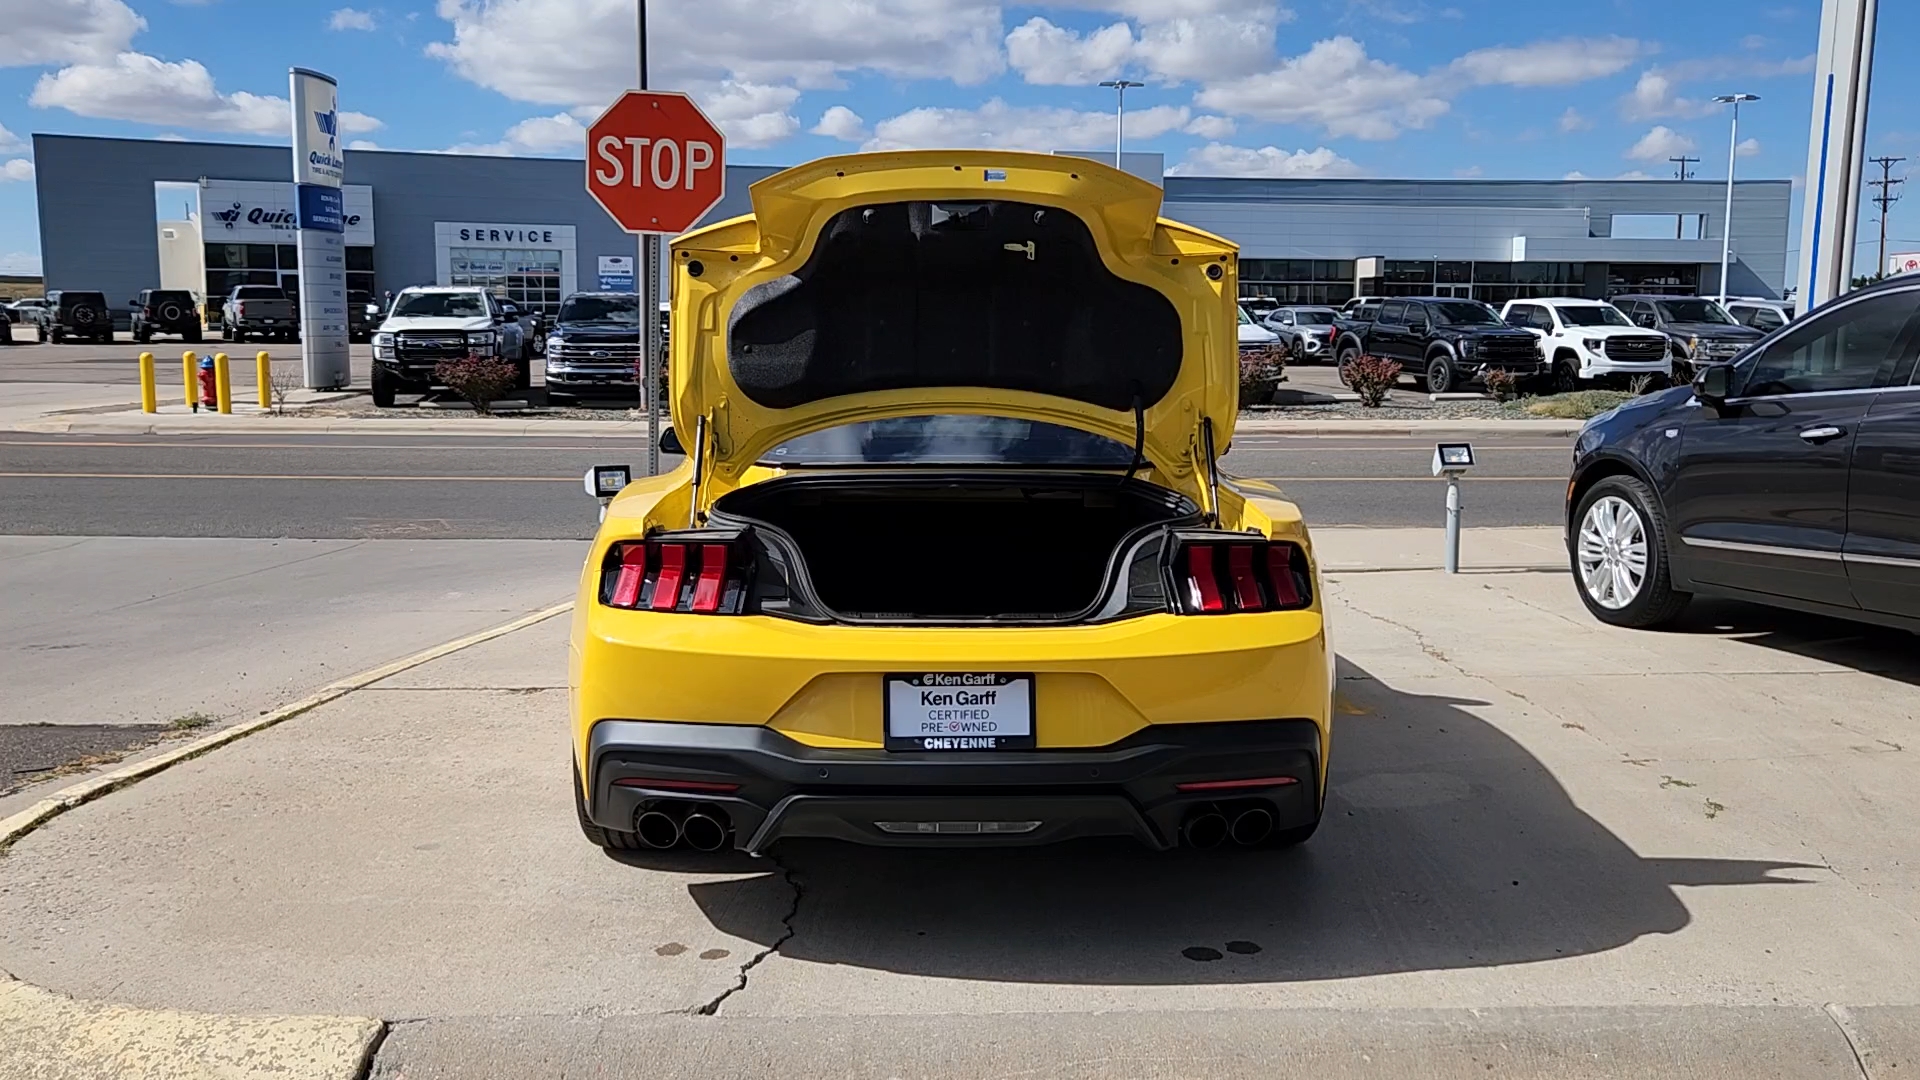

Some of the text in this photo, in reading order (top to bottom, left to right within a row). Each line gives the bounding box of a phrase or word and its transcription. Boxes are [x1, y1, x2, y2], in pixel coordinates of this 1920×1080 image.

[309, 150, 331, 166] Quick
[596, 135, 714, 190] STOP
[460, 229, 553, 242] SERVICE
[936, 673, 995, 685] Ken Garff
[921, 690, 997, 706] Ken Garff
[928, 709, 990, 720] CERTIFIED
[924, 737, 996, 749] CHEYENNE
